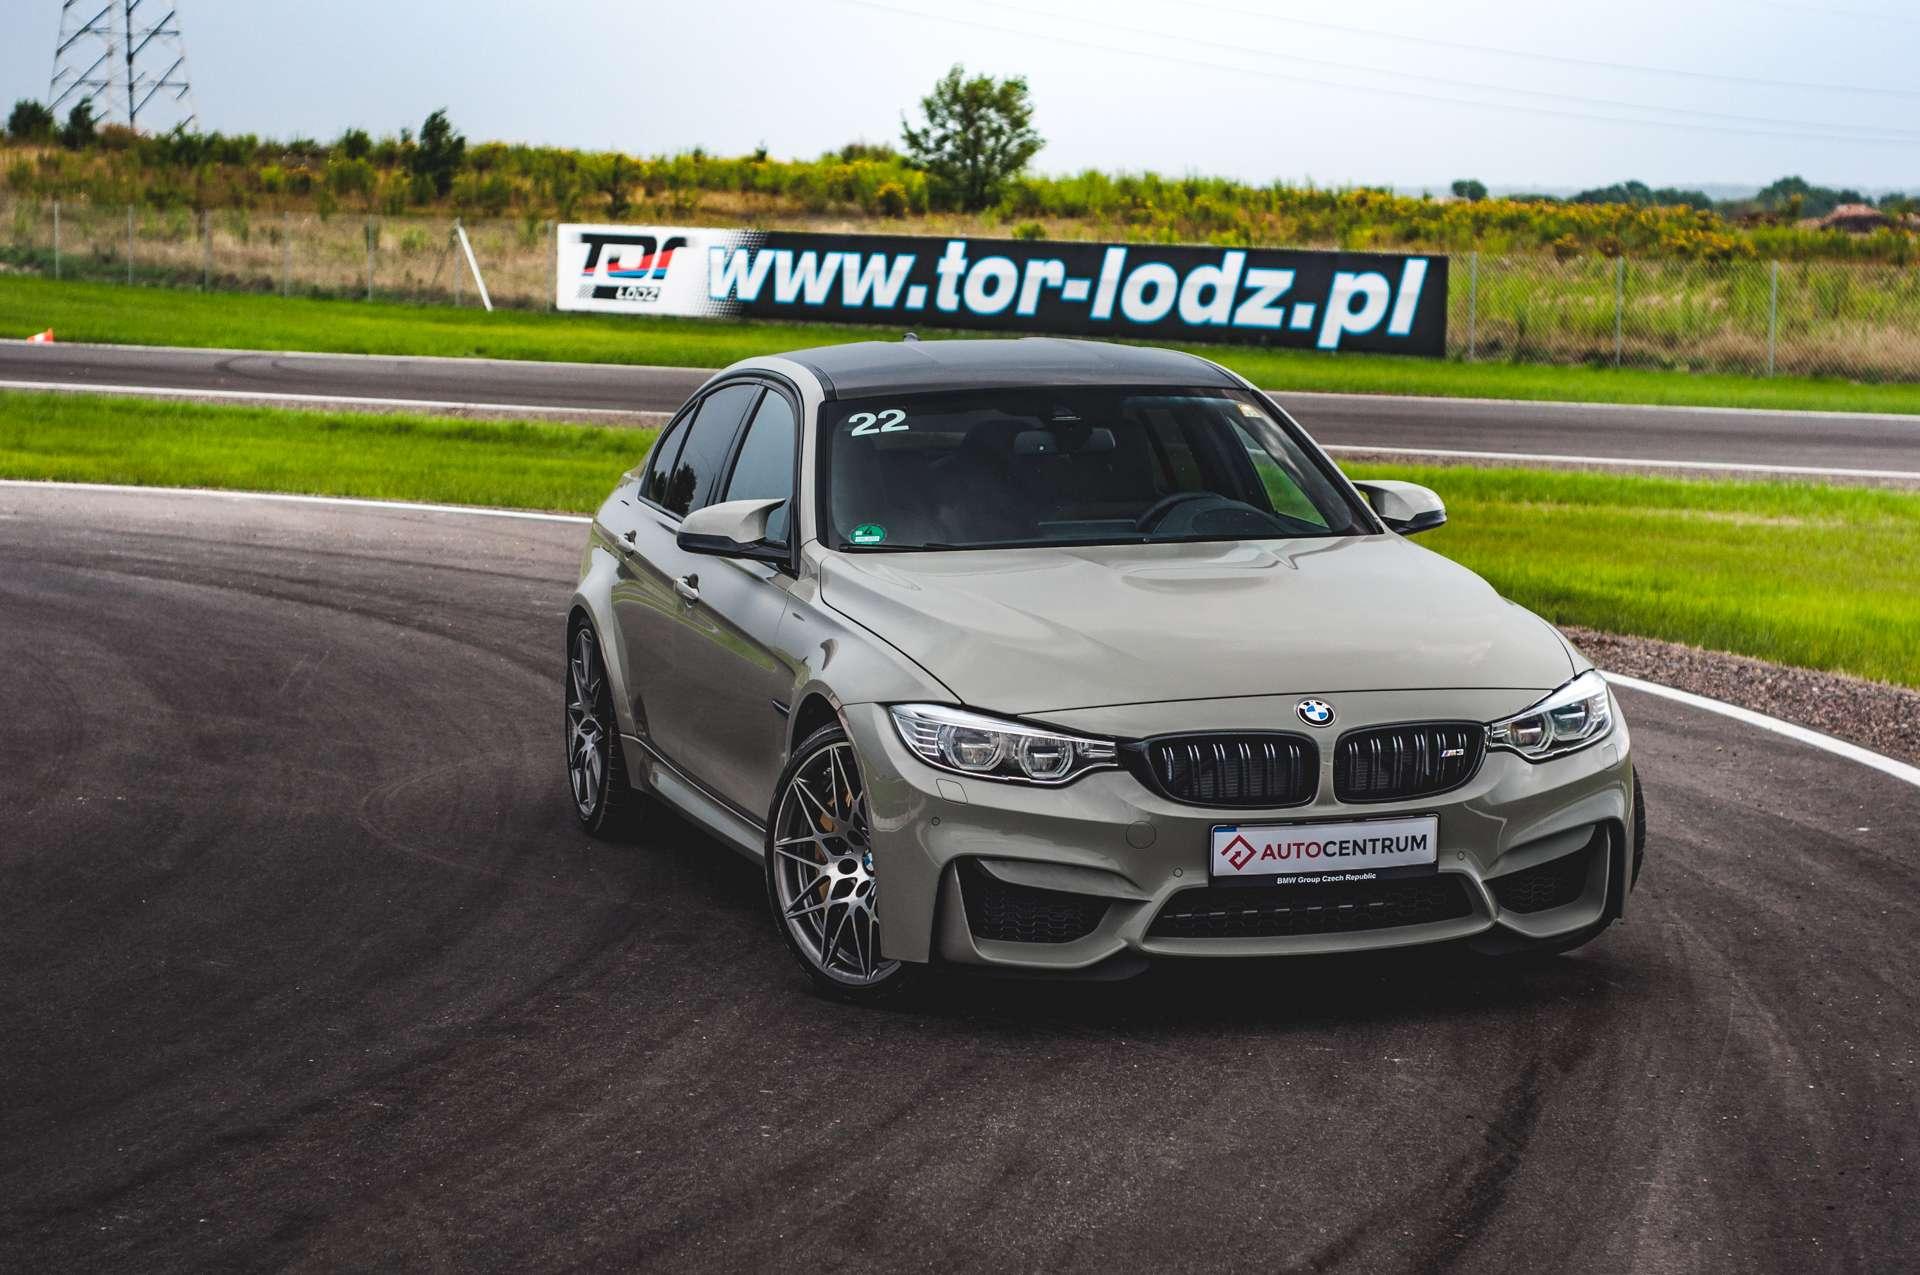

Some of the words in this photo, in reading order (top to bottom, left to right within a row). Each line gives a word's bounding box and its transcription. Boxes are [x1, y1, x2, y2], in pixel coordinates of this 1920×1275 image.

[707, 241, 1429, 349] www.tor-lodz.pl
[848, 409, 909, 437] 22
[1260, 834, 1427, 860] AUTOCENTRUM
[1277, 877, 1297, 885] BMW
[1298, 876, 1320, 884] Group
[1322, 874, 1344, 882] Czech
[1345, 872, 1377, 881] Republic
